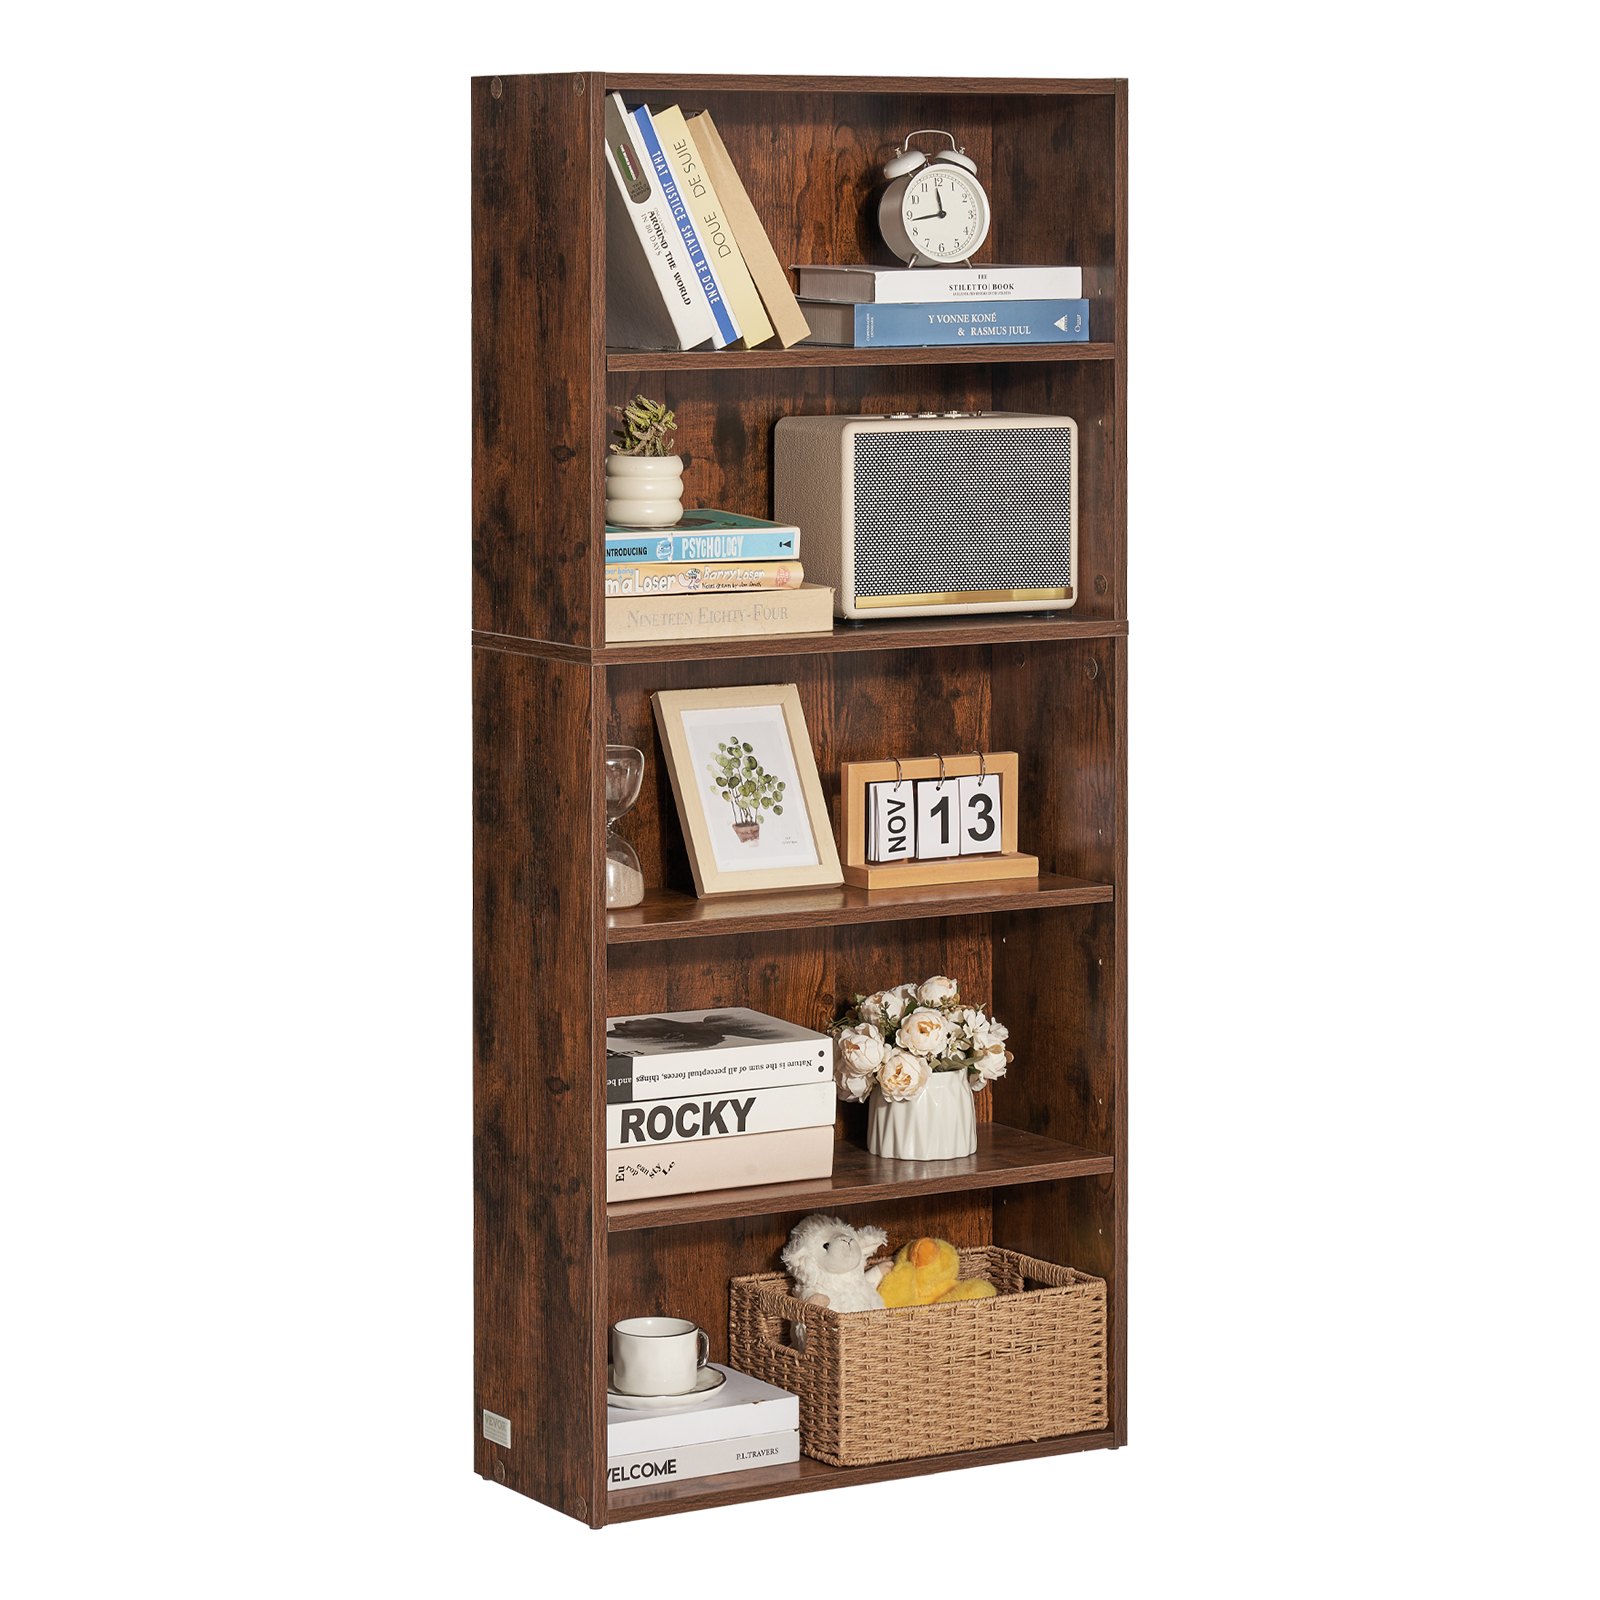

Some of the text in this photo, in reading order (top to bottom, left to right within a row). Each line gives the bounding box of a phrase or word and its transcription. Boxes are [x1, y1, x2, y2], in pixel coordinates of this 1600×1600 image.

[934, 178, 943, 186] 12
[922, 183, 928, 192] 11
[674, 138, 732, 258] DOUE DE SUIE
[912, 195, 919, 204] 10
[962, 194, 967, 202] 2
[906, 210, 912, 220] 9
[968, 210, 973, 220] 3
[652, 150, 721, 304] THAT JUSTICE SHALL BE DONE
[912, 227, 918, 236] 8
[963, 226, 968, 235] 4
[650, 234, 662, 256] DAYS
[925, 238, 930, 247] 7
[939, 243, 944, 252] 6
[954, 239, 960, 248] 5
[648, 210, 668, 249] AROUND
[664, 251, 676, 270] THE
[673, 272, 691, 306] WORLD
[971, 312, 997, 323] KONÉ
[958, 326, 1031, 336] & RASMUS JUUL
[606, 536, 744, 559] NTRODUCING PSYCHOLOGY
[621, 578, 633, 593] a
[634, 568, 676, 593] Loser
[887, 798, 907, 853] NOV
[687, 1067, 726, 1079] perceptual
[739, 1066, 747, 1074] of
[618, 1077, 632, 1086] and
[636, 1074, 660, 1083] things
[620, 1097, 756, 1144] ROCKY
